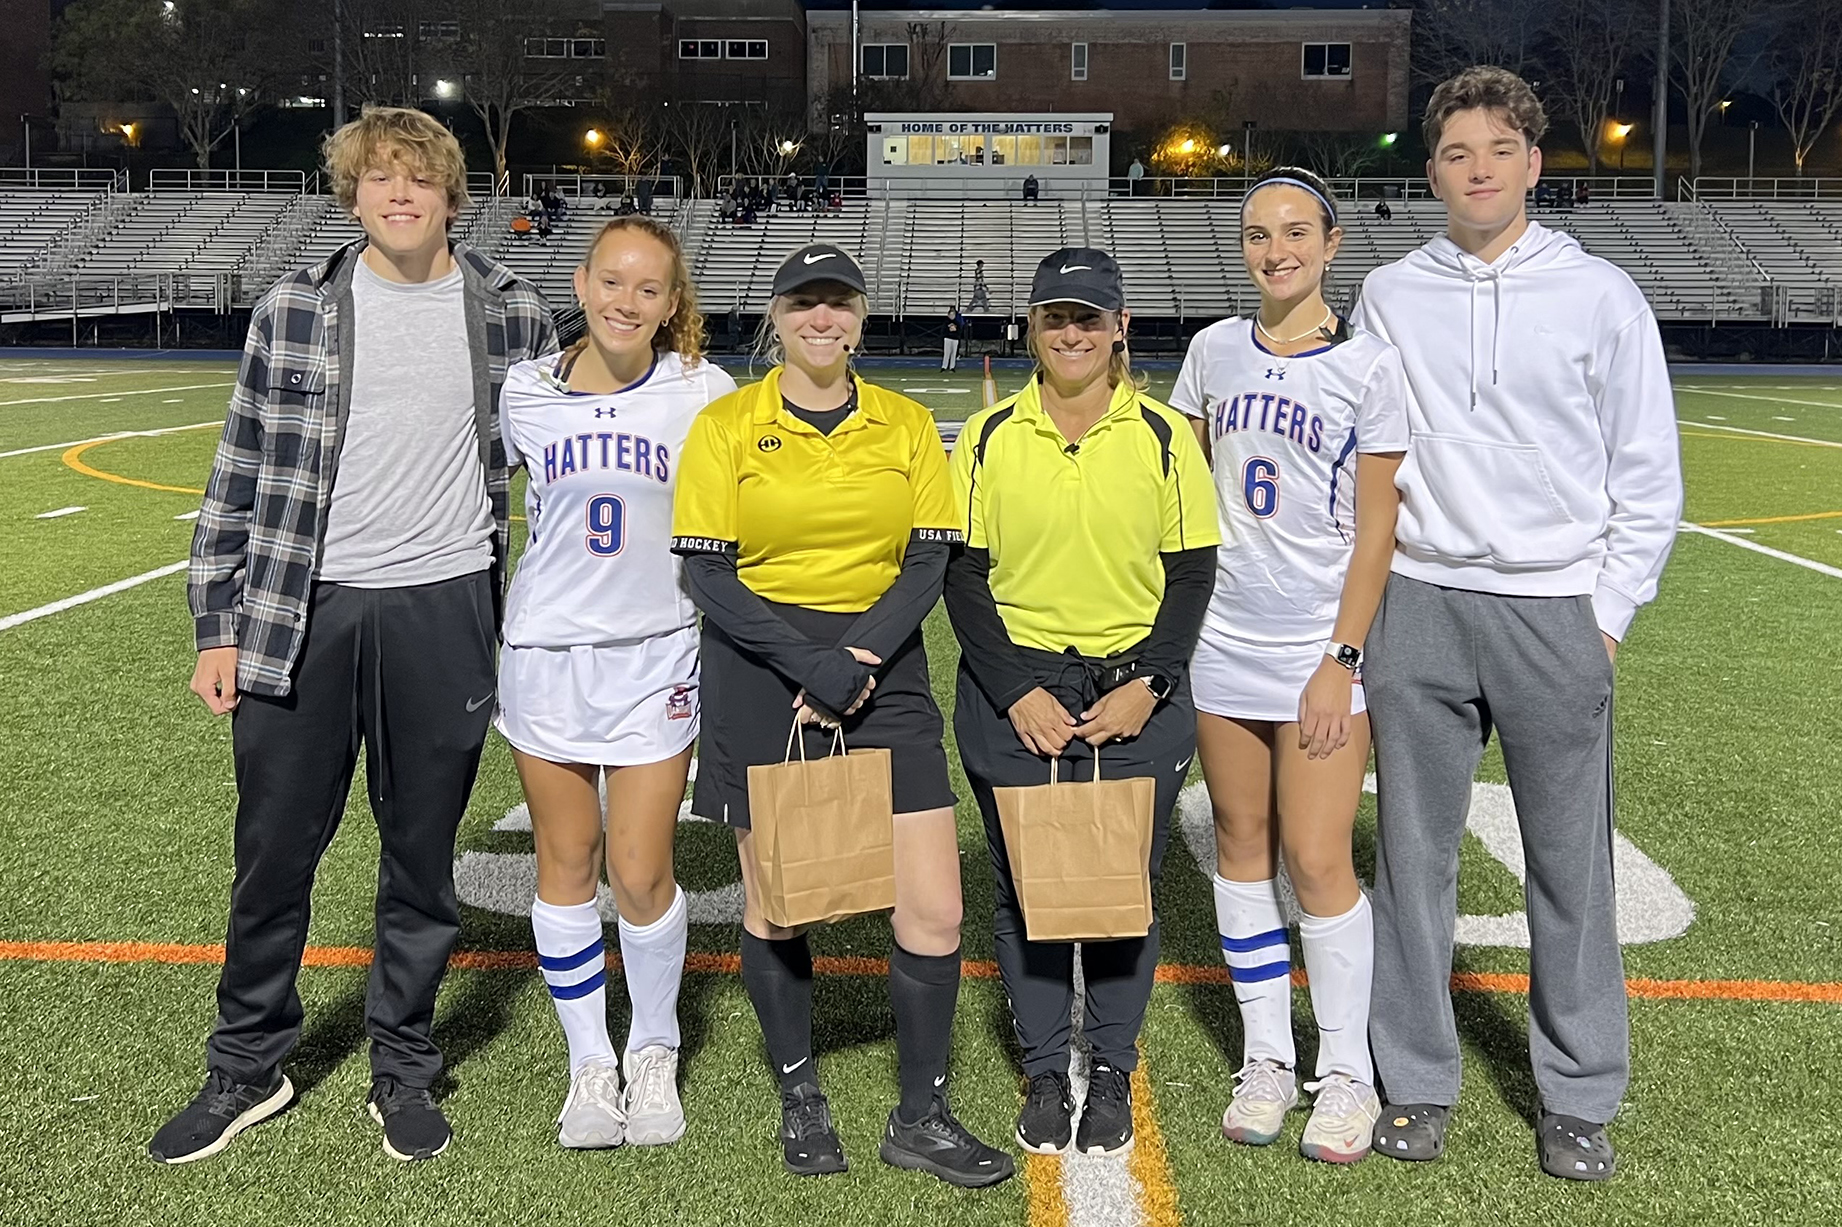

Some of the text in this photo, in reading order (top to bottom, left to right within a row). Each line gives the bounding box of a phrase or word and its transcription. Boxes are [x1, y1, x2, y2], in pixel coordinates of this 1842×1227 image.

[901, 123, 1074, 133] HOME OF THE HATTERS
[1214, 391, 1324, 454] HATTERS
[543, 431, 670, 486] HATTERS
[1241, 456, 1280, 520] 6
[585, 493, 626, 558] 9
[680, 537, 729, 553] HOCKEY
[918, 528, 943, 541] USA
